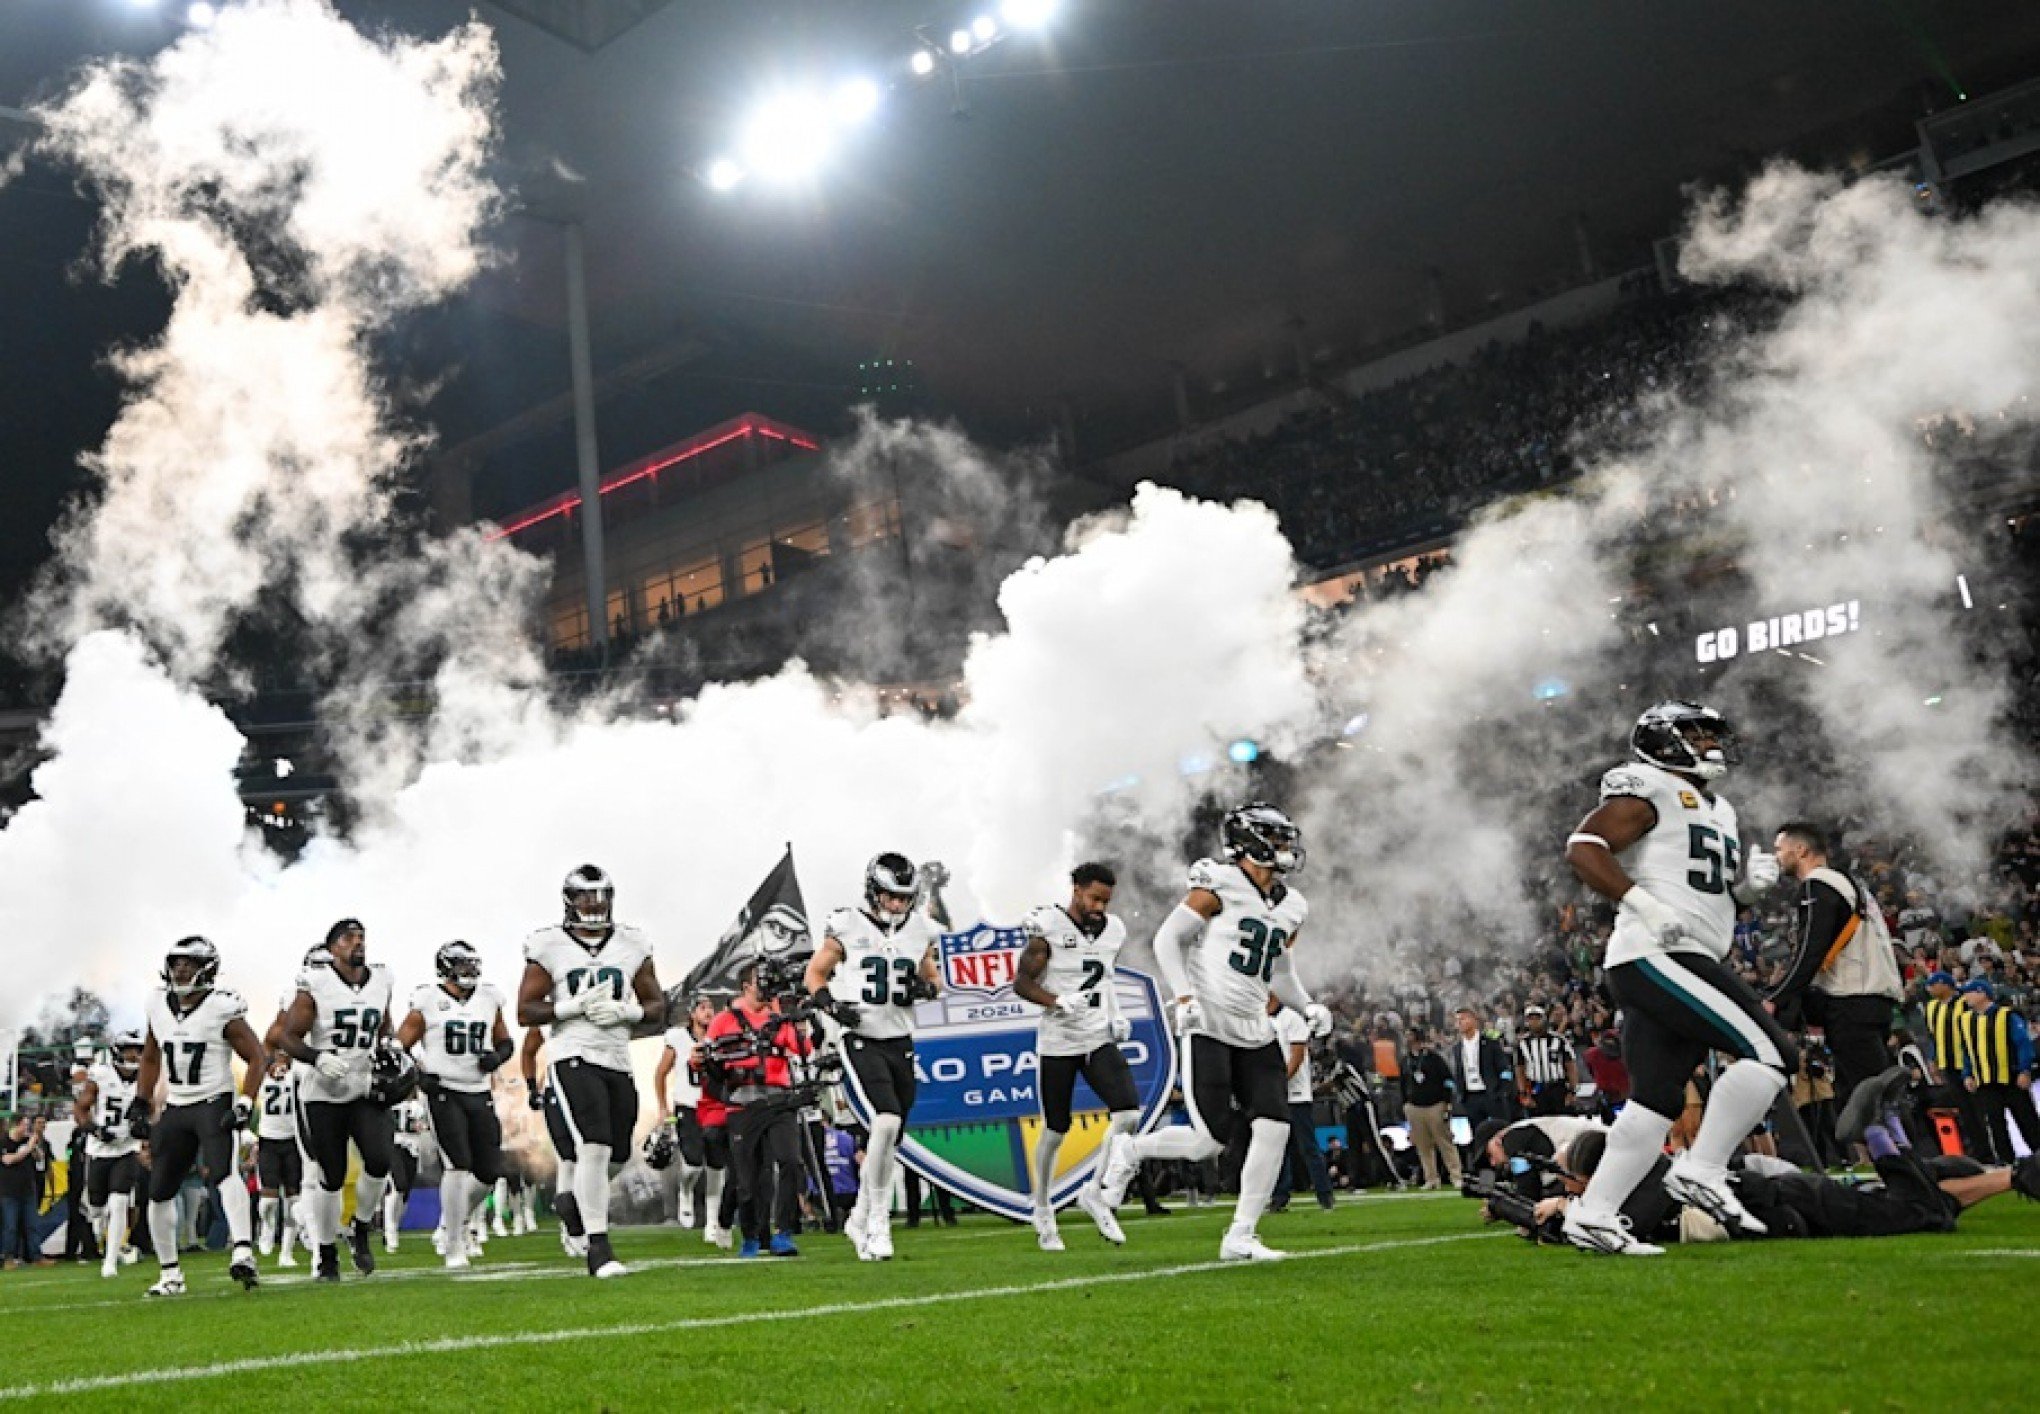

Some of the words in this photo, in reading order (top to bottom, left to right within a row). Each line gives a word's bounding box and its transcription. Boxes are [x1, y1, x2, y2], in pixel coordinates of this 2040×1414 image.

[1696, 627, 1738, 663] GO
[1747, 599, 1860, 653] BIRDS!
[860, 956, 917, 1006] 33
[1079, 959, 1104, 1007] 2
[331, 1008, 380, 1047] 59
[968, 1003, 1024, 1019] 2024
[445, 1020, 487, 1055] 68
[164, 1042, 207, 1085] 17
[963, 1085, 1033, 1105] GAM
